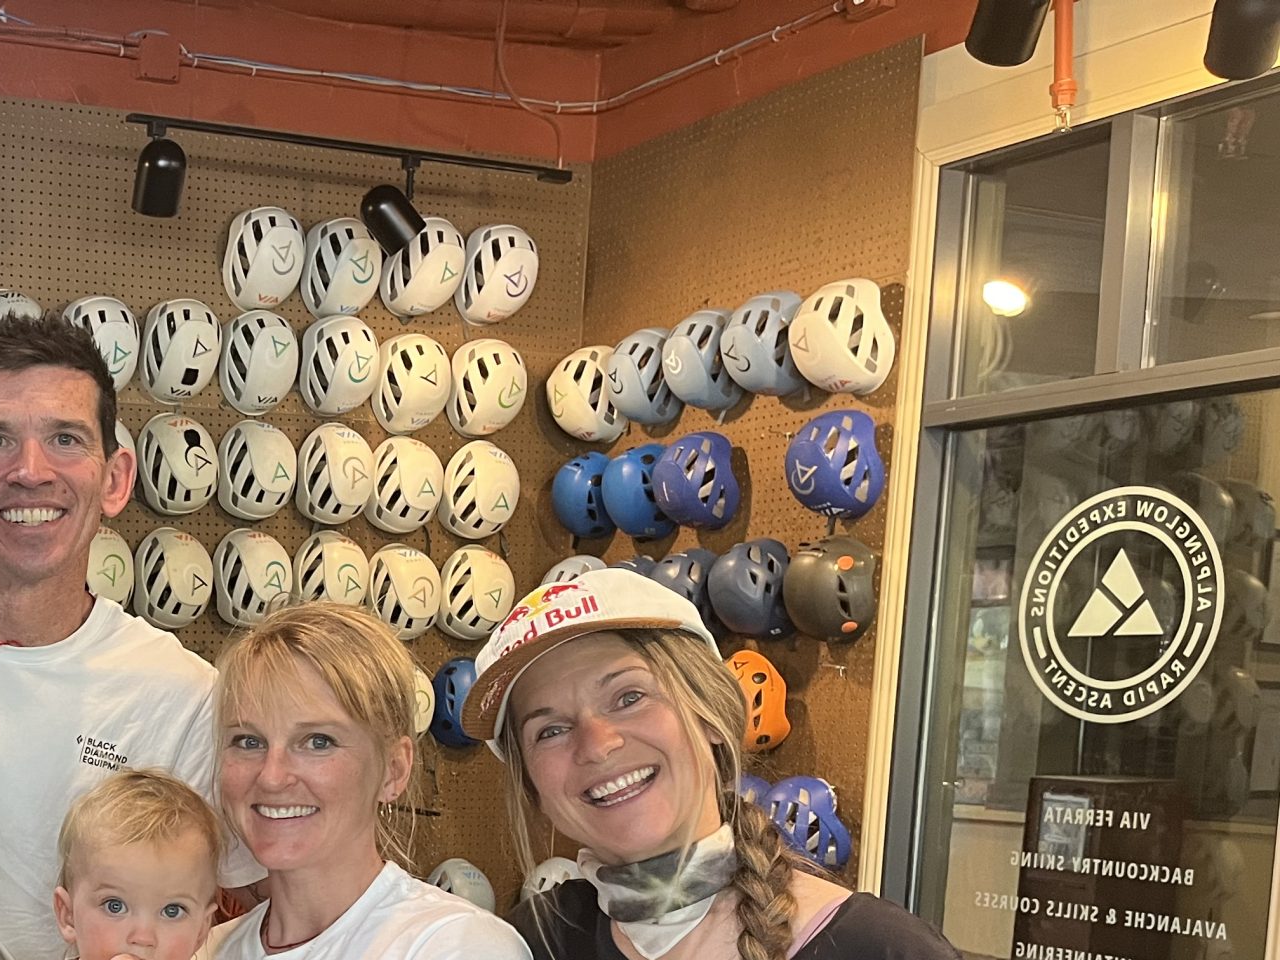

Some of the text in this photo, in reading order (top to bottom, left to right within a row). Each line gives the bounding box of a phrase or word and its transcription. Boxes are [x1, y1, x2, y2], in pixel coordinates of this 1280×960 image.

[545, 595, 599, 629] Bull
[86, 737, 117, 752] BLACK
[84, 746, 128, 764] DIAMOND
